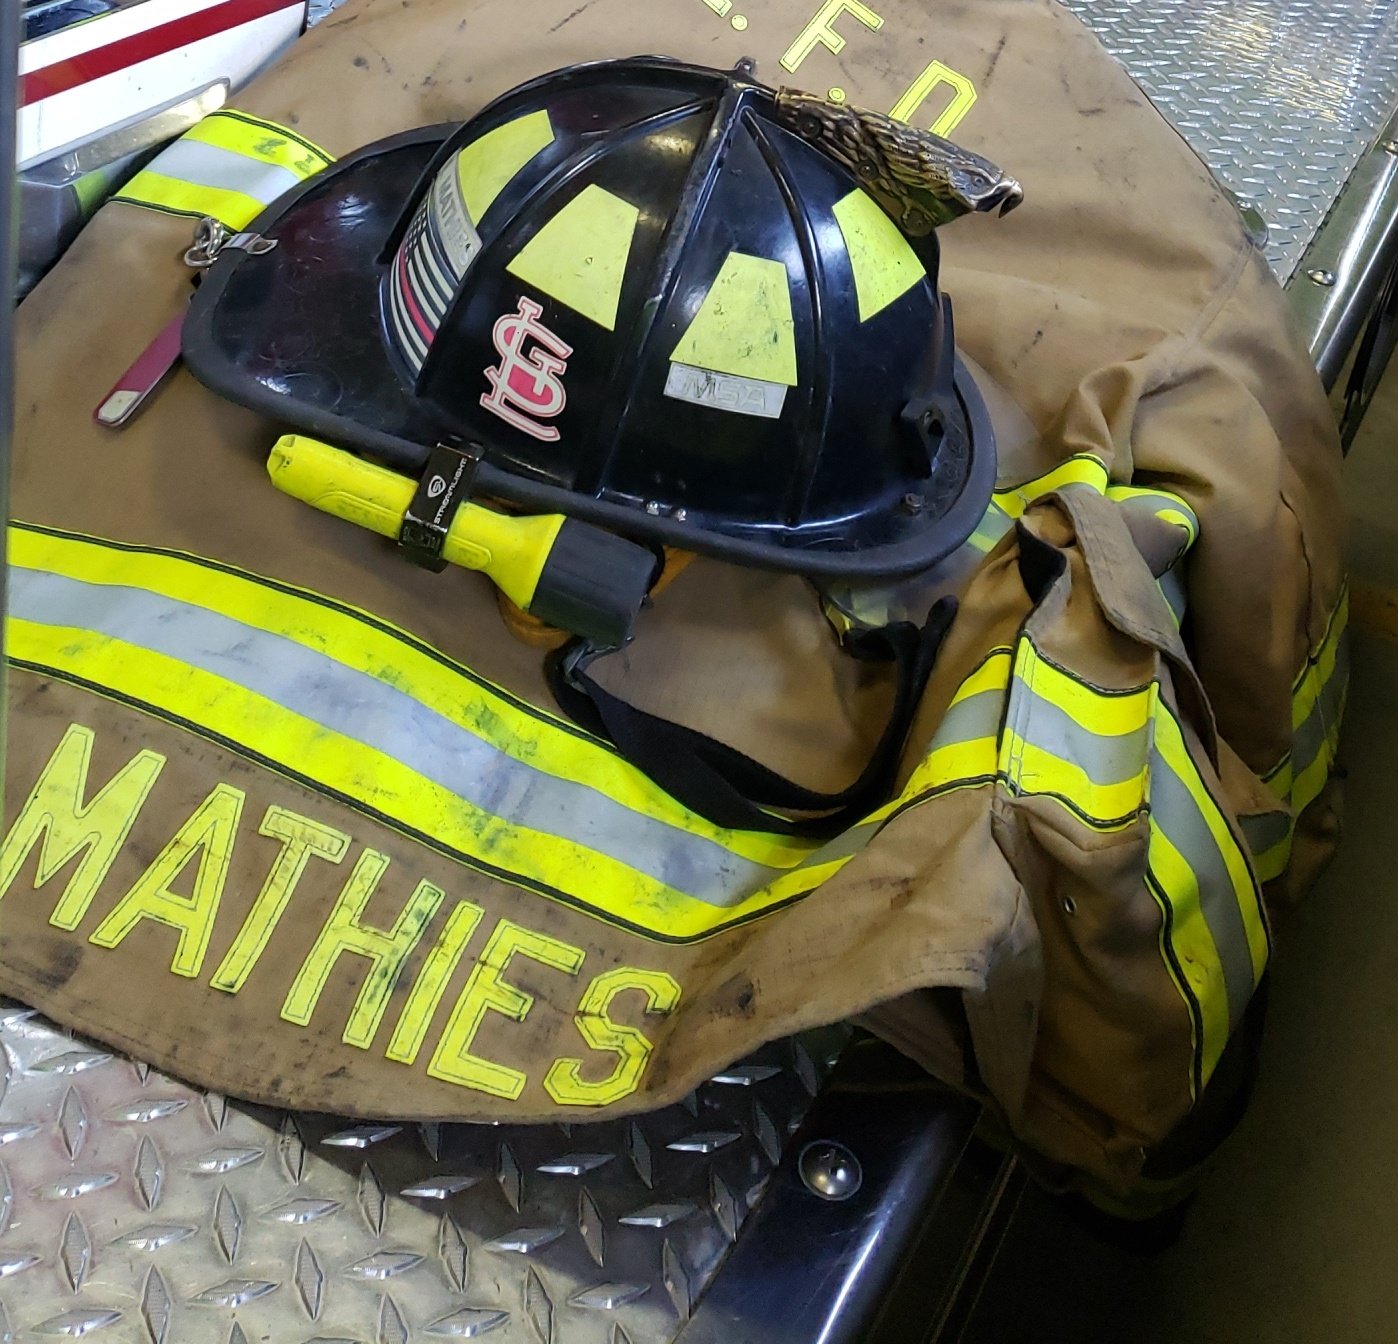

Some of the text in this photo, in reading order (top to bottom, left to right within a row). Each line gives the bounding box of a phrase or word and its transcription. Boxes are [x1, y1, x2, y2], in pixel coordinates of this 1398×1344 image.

[681, 372, 767, 412] MSA
[433, 457, 468, 525] STREAMLIGHT
[0, 722, 682, 1106] MATHIES
